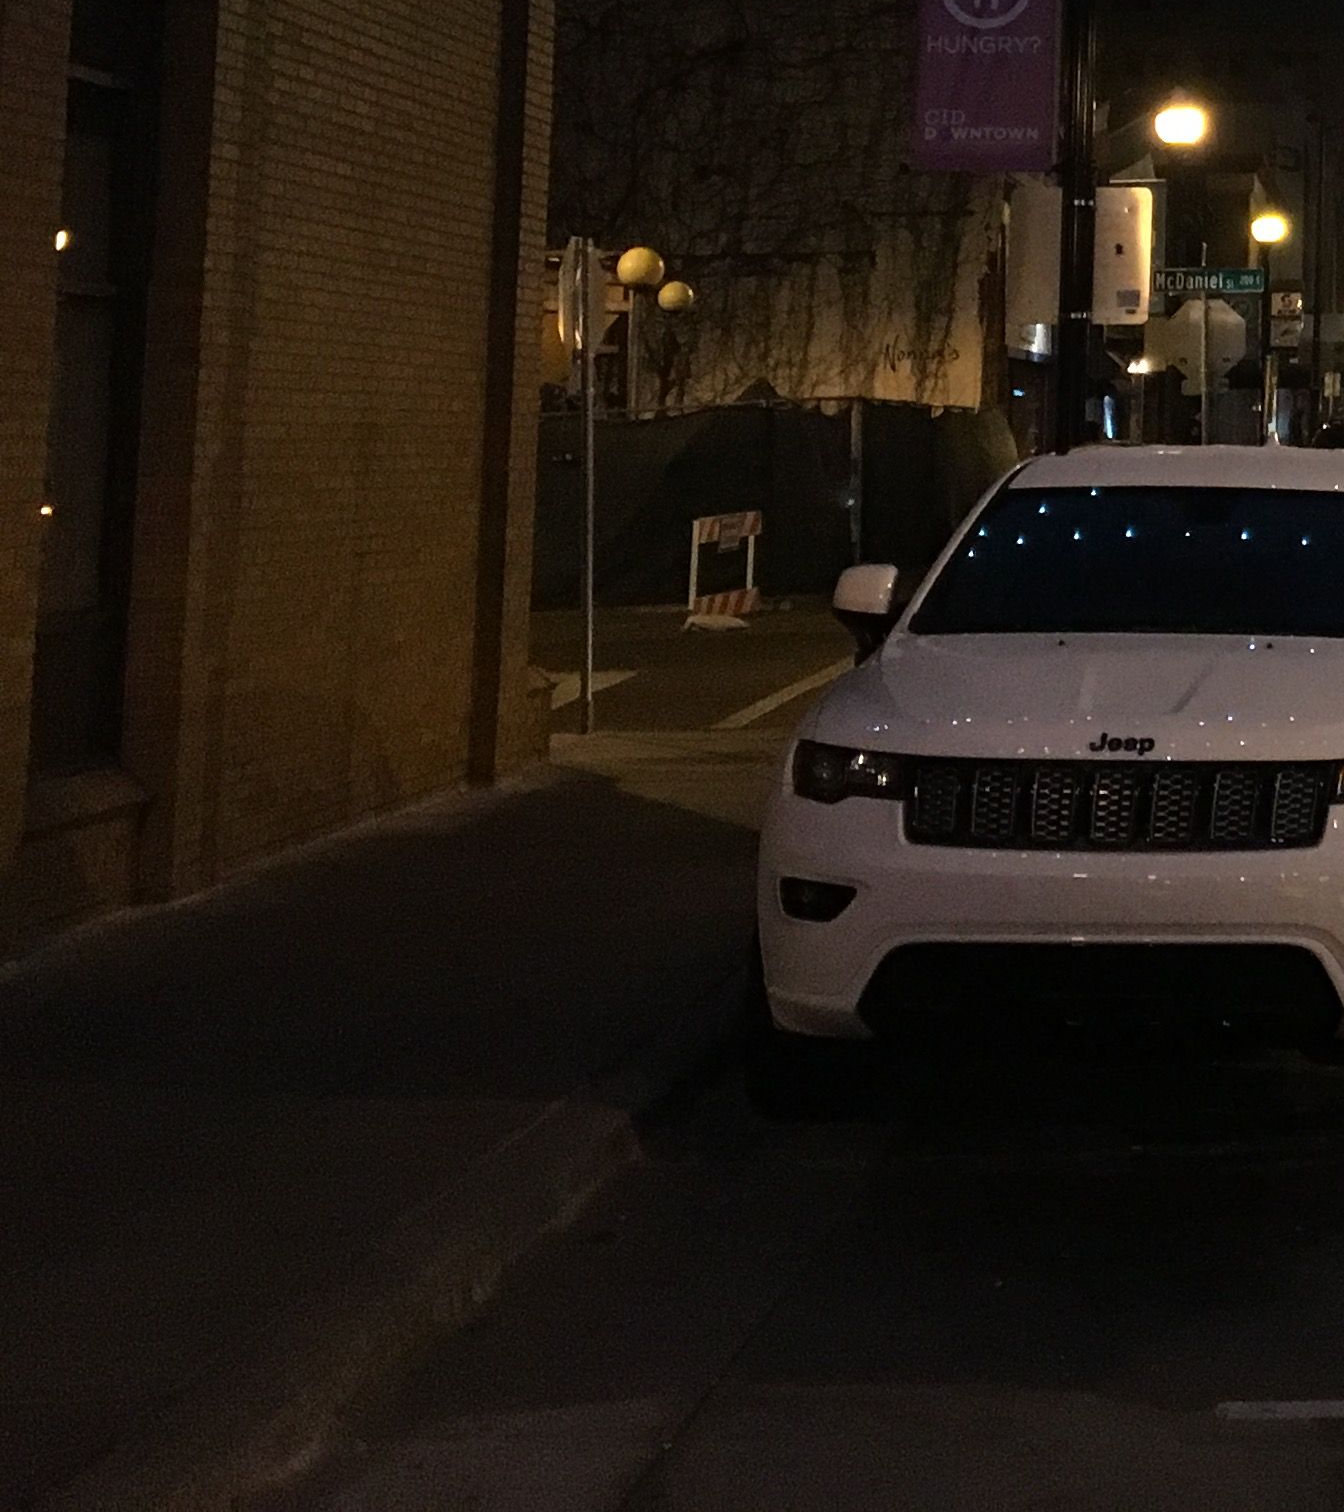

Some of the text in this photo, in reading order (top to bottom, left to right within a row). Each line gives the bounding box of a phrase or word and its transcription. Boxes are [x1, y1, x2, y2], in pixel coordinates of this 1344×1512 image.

[926, 35, 1042, 55] HUNGRY?
[924, 127, 1040, 141] DWNTOWN
[1155, 272, 1223, 289] McDaniel
[1089, 732, 1155, 756] Jeep
